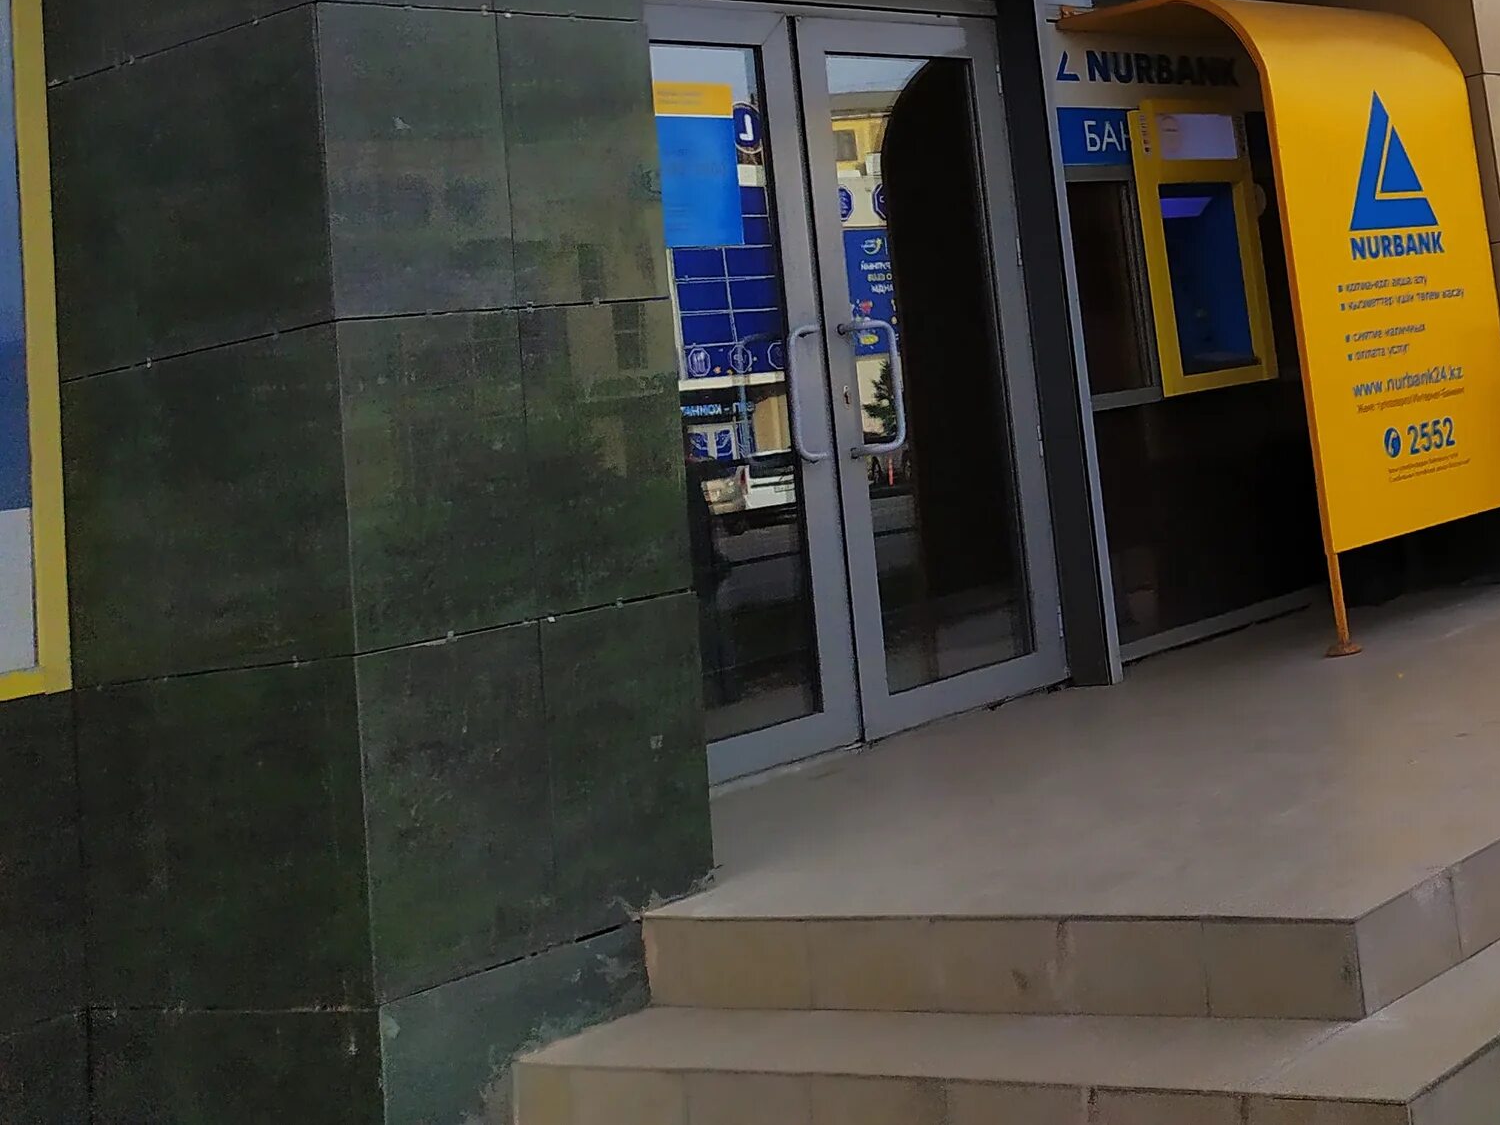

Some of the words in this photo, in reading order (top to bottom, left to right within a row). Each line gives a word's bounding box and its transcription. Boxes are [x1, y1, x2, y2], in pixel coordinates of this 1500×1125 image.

[1085, 49, 1240, 87] NURBANK
[1350, 231, 1445, 260] NURBANK
[1353, 365, 1465, 398] www.nurbank24.kz
[1407, 416, 1456, 456] 2552
